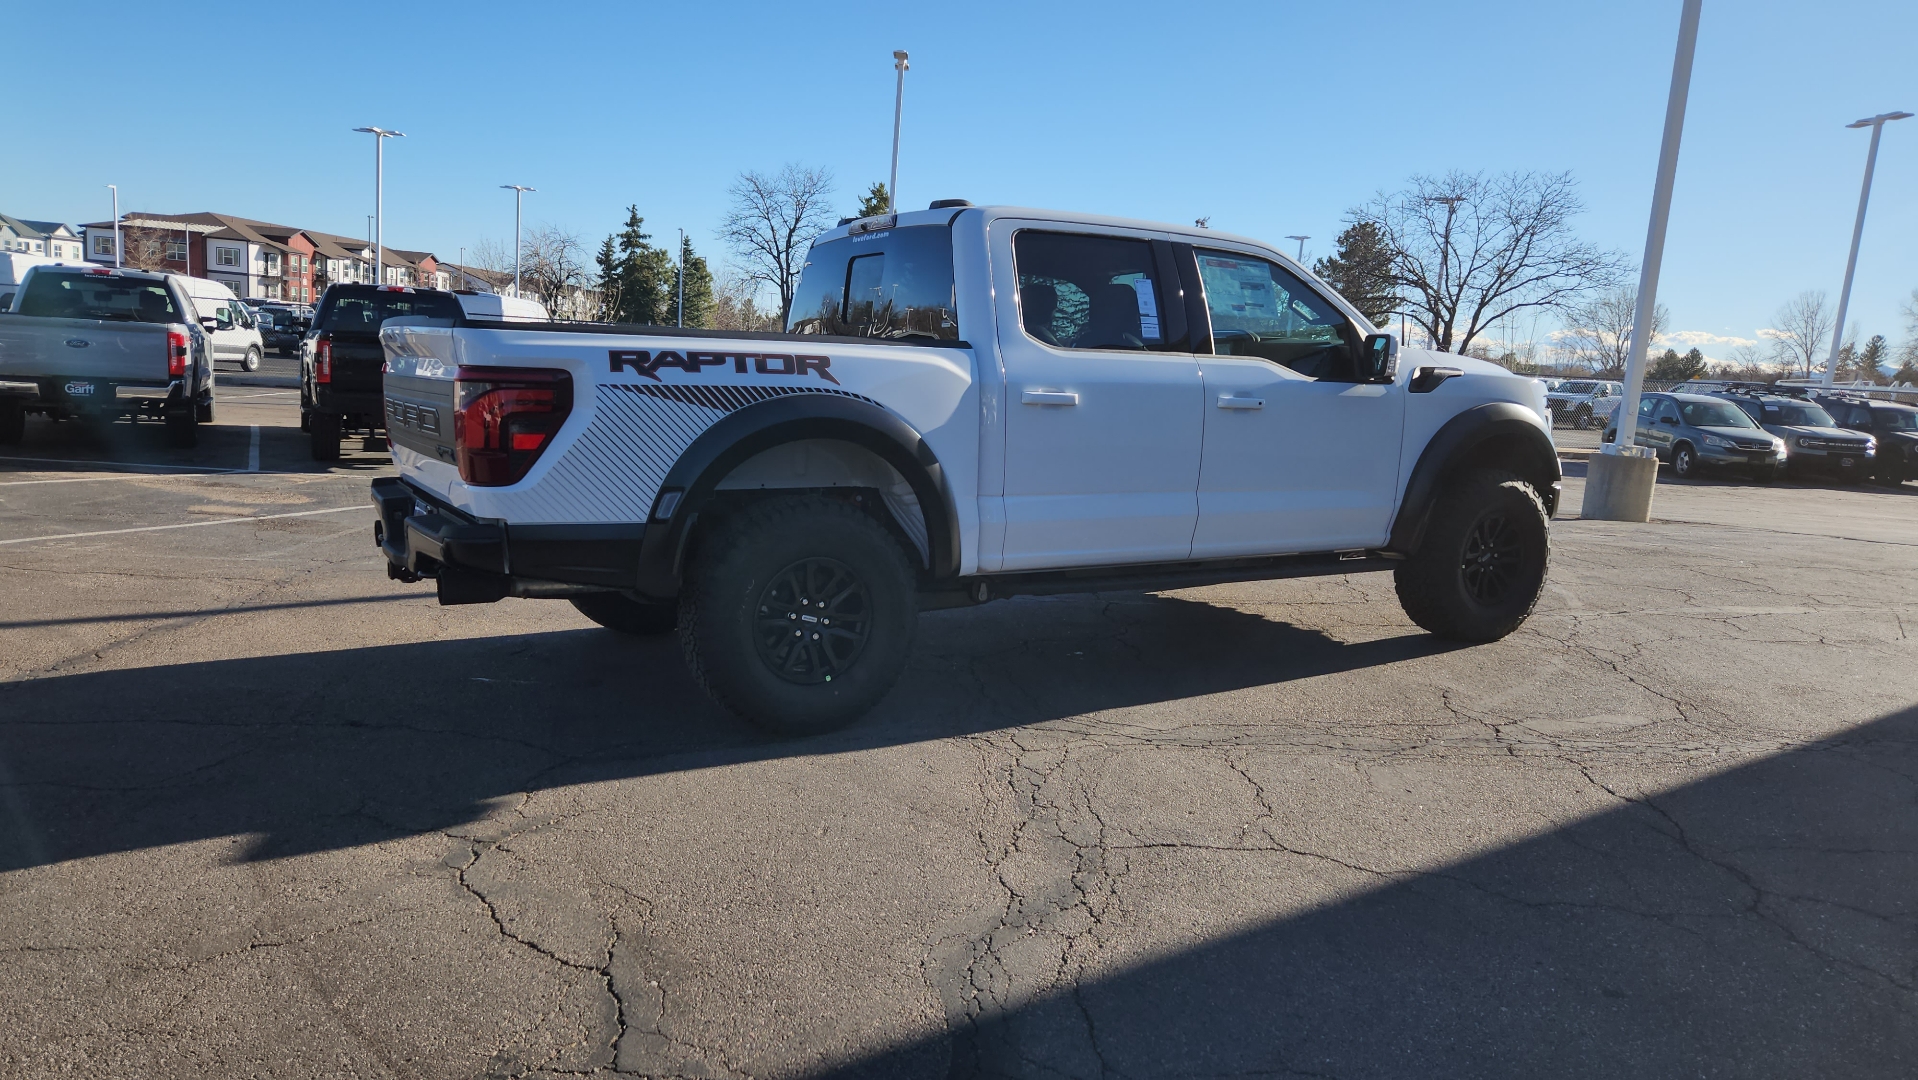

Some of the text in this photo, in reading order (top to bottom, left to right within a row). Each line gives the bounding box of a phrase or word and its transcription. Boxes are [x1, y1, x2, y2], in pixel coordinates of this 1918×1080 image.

[608, 350, 841, 387] RAPTOR
[64, 383, 95, 394] Garff
[385, 397, 441, 436] FORD
